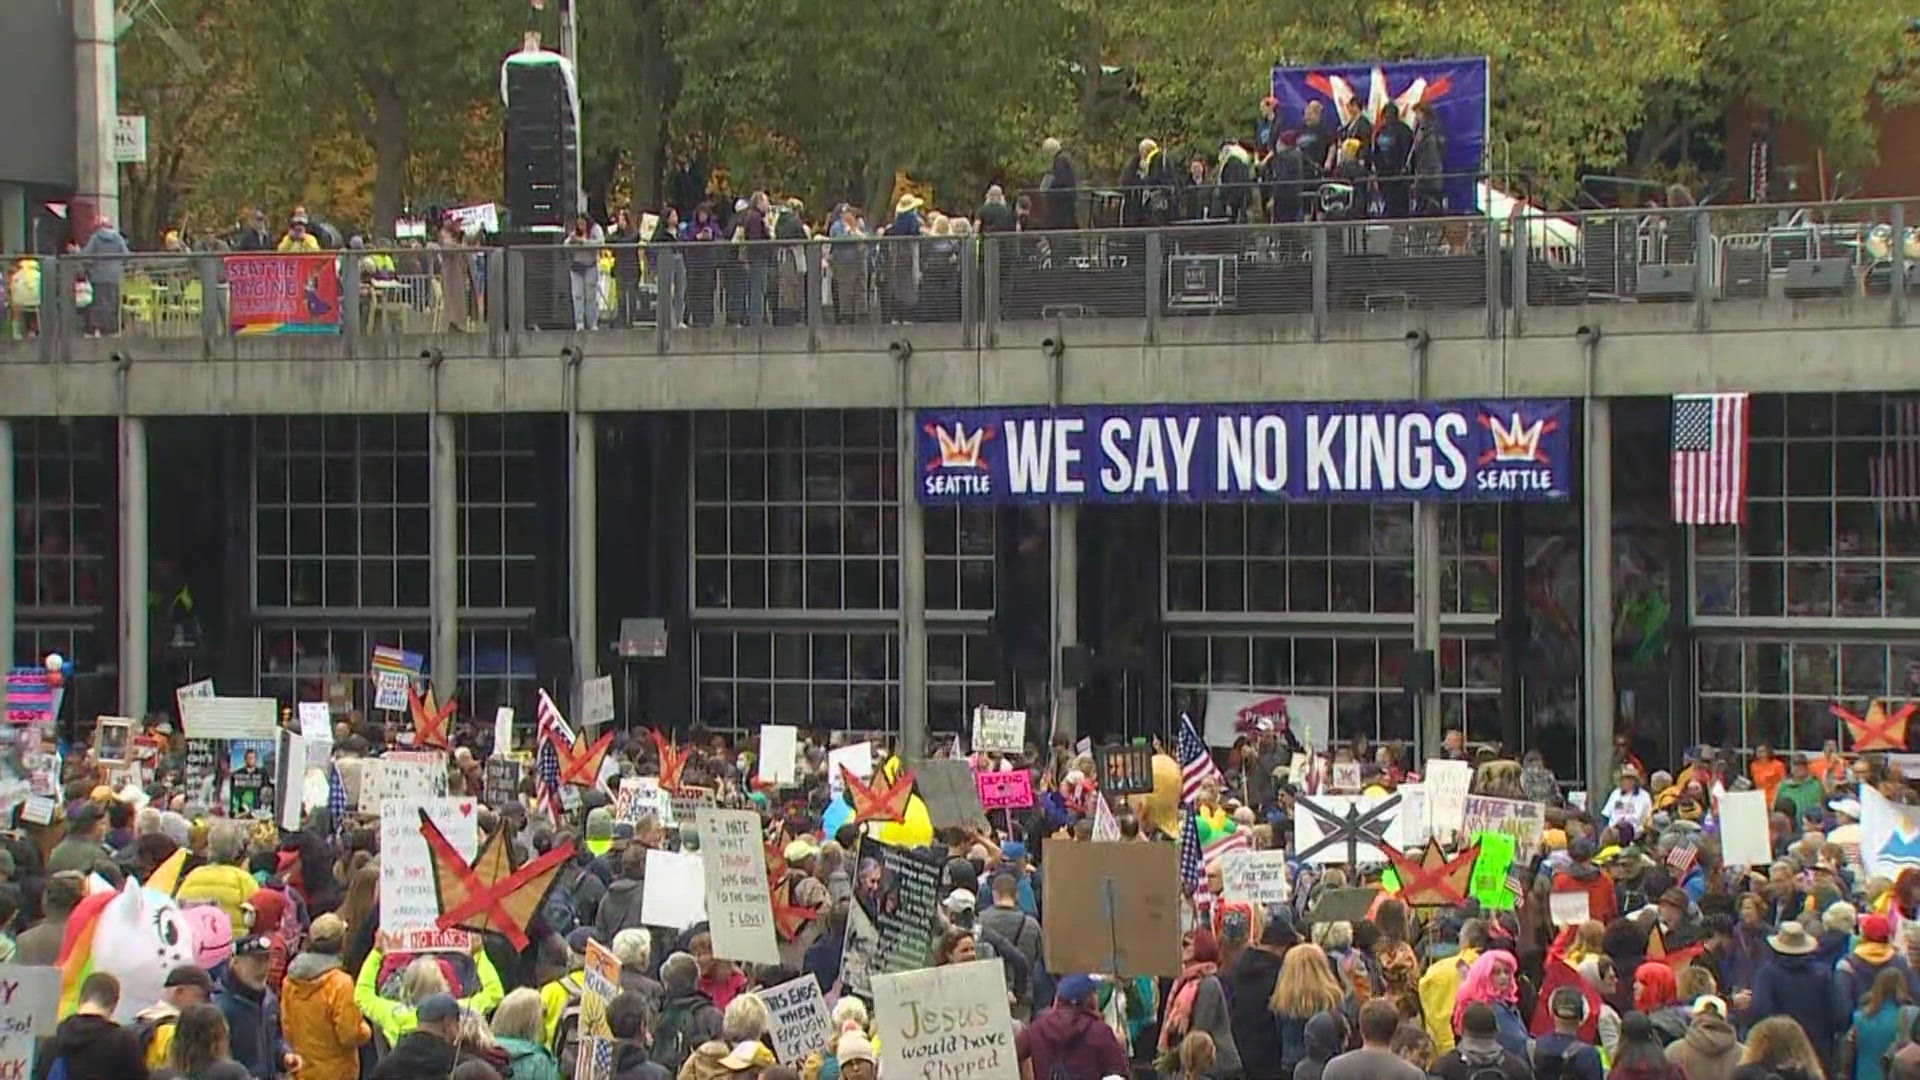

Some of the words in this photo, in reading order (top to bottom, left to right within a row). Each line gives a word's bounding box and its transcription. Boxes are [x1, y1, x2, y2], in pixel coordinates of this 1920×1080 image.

[230, 261, 297, 277] SEATTLE
[231, 281, 297, 296] RAGING
[1004, 418, 1084, 494] WE
[1100, 416, 1201, 493] SAY
[1216, 414, 1288, 492] NO
[1307, 411, 1467, 492] KINGS
[925, 474, 991, 495] SEATTLE
[1478, 469, 1553, 491] SEATTLE
[385, 768, 409, 778] THIS
[1466, 799, 1510, 817] HATE
[710, 819, 716, 833] I
[726, 820, 750, 834] HATE
[718, 837, 745, 852] WHAT
[720, 854, 752, 868] TRUMP
[729, 911, 735, 924] I
[411, 931, 428, 948] NO
[431, 931, 469, 948] KINGS
[788, 982, 818, 1005] ENDS
[780, 1004, 815, 1025] WHEN
[900, 1000, 989, 1040] Jesus
[776, 1015, 827, 1043] ENOUGH
[787, 1040, 801, 1057] OF
[805, 1033, 825, 1050] US
[902, 1036, 957, 1059] would
[960, 1031, 1007, 1051] have
[922, 1049, 1000, 1080] flipped
